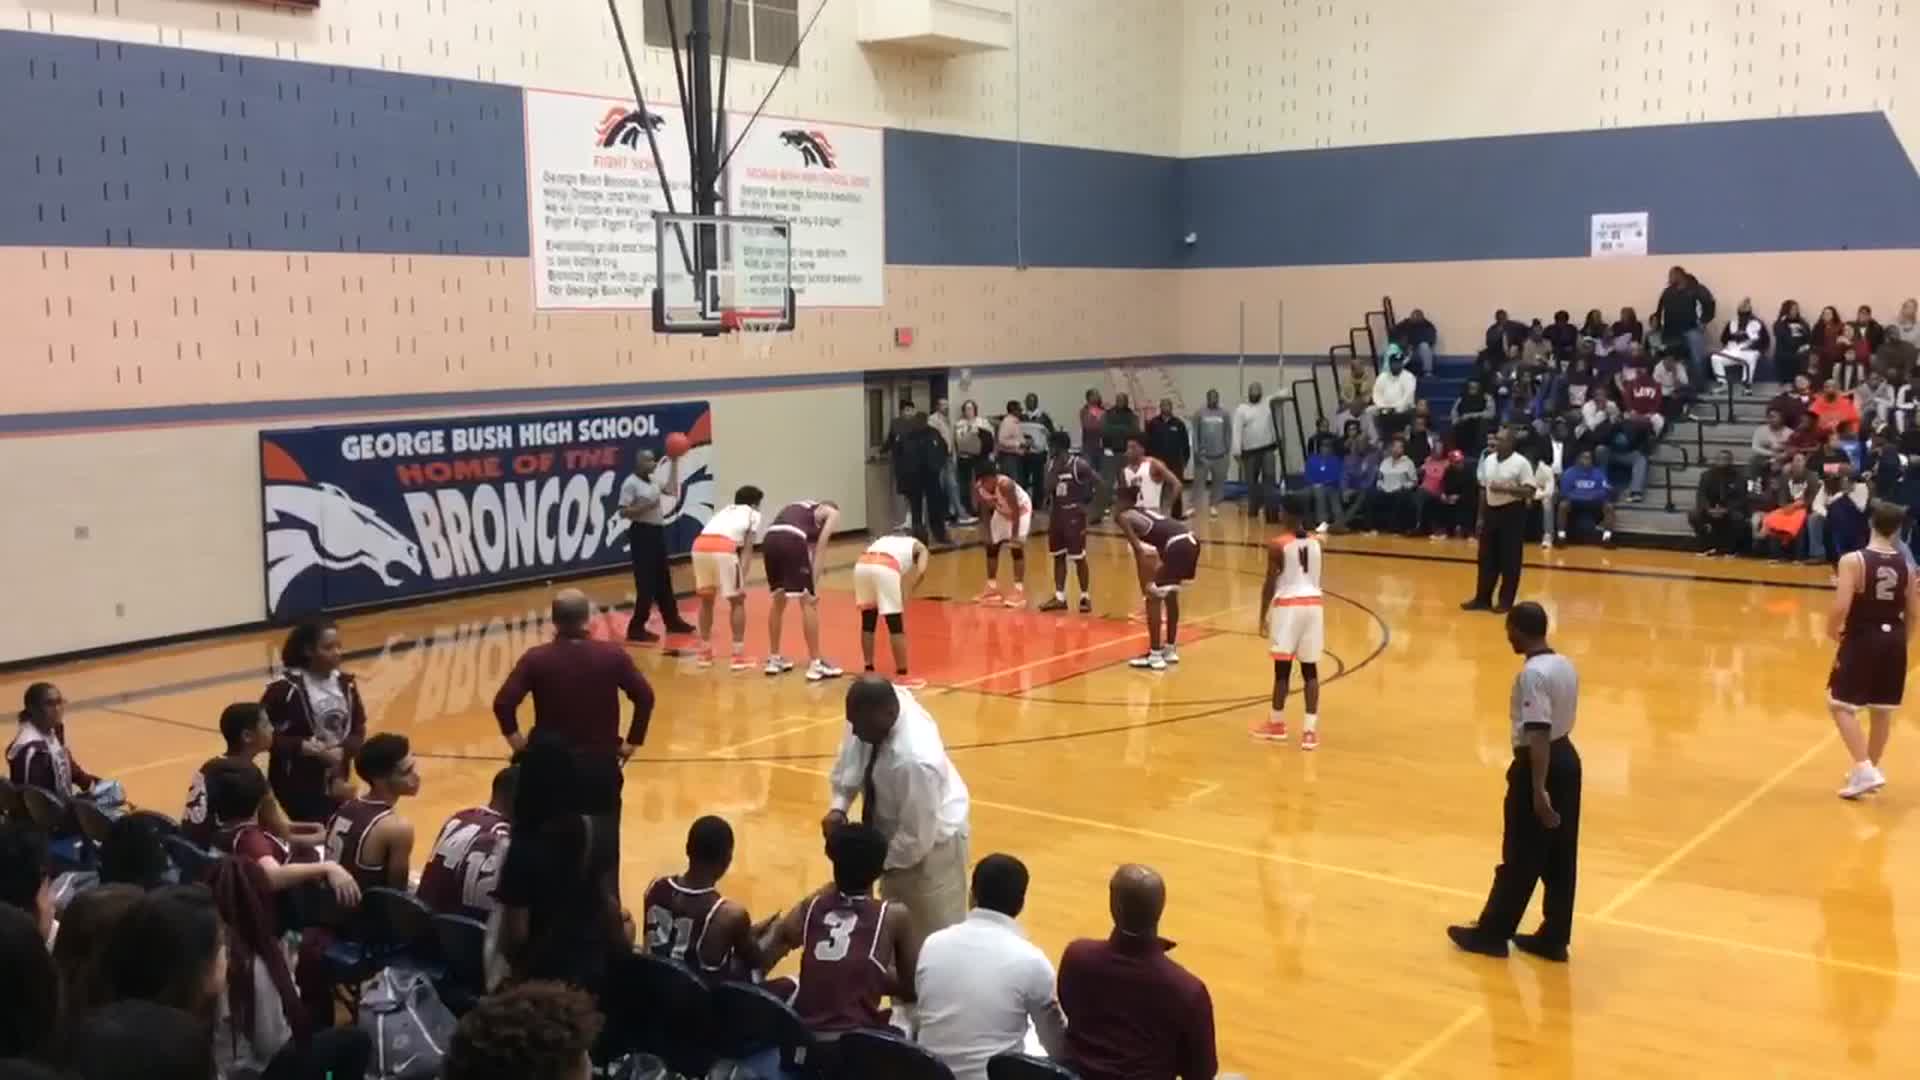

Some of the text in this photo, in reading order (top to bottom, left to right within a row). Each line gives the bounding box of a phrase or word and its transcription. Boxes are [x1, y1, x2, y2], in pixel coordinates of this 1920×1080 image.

[341, 414, 659, 461] GEORGE BUSH HIGH SCHOOL
[395, 447, 619, 486] HOME OF THE
[403, 470, 616, 581] BRONCOS
[1298, 546, 1308, 574] 4
[1876, 565, 1898, 600] 2
[813, 911, 858, 961] 3
